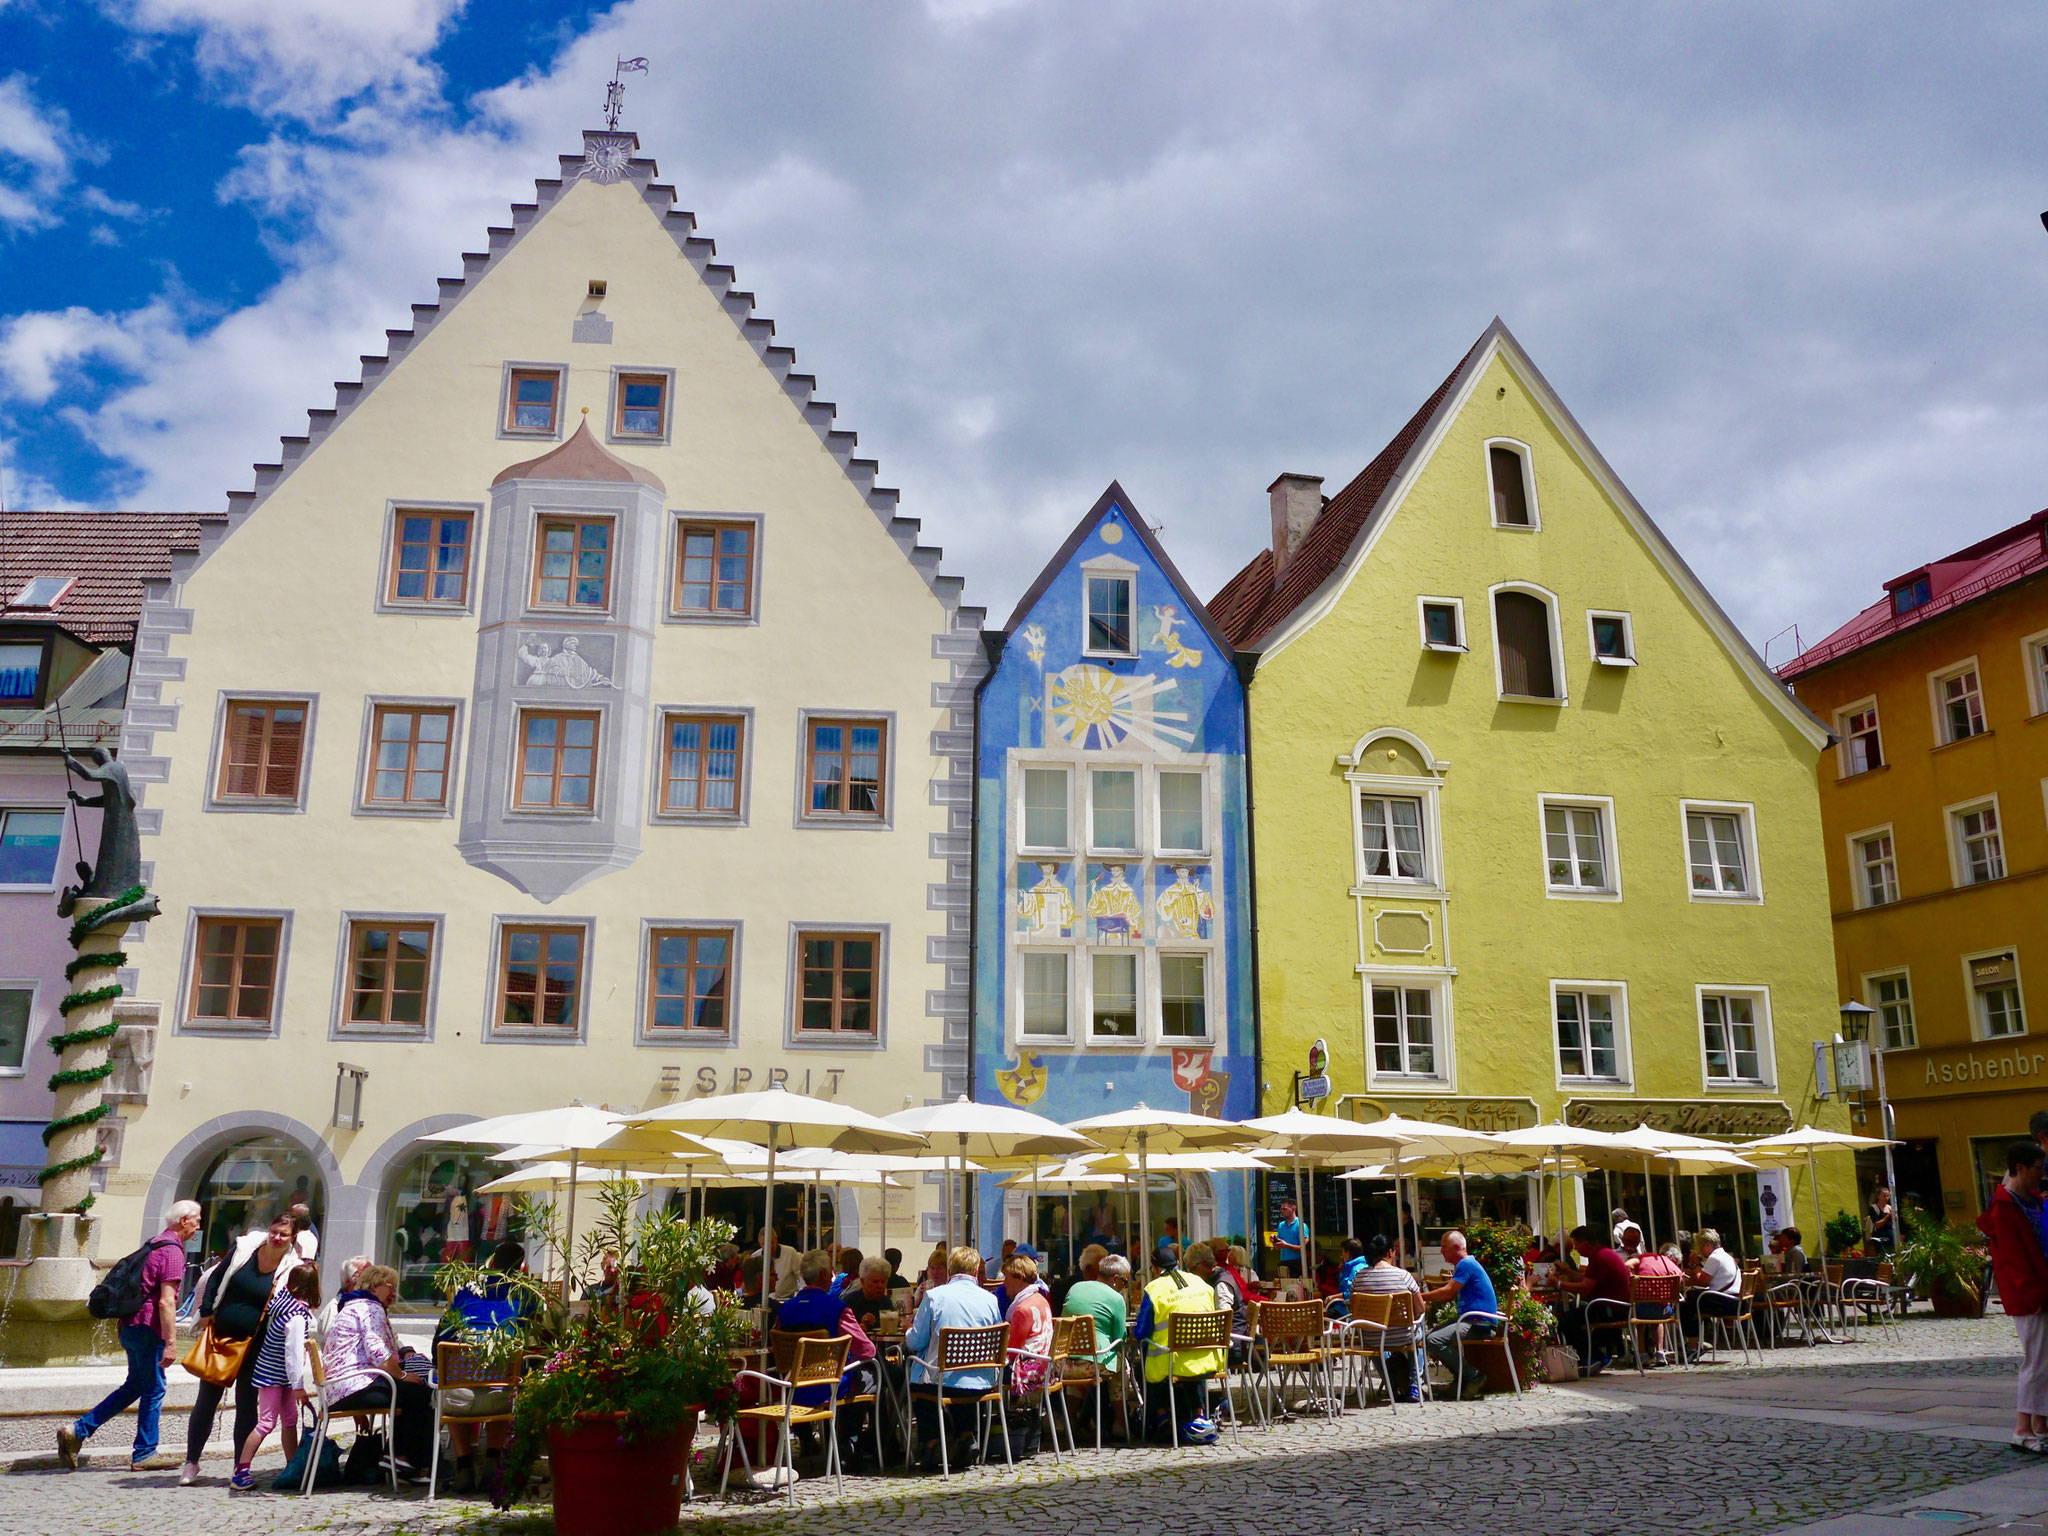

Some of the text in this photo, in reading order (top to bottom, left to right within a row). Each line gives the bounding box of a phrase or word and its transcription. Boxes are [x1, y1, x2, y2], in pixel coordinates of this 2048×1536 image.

[1976, 965, 2000, 977] SALON
[660, 1065, 845, 1095] ESPRIT
[1925, 1047, 2046, 1085] Aschenbr
